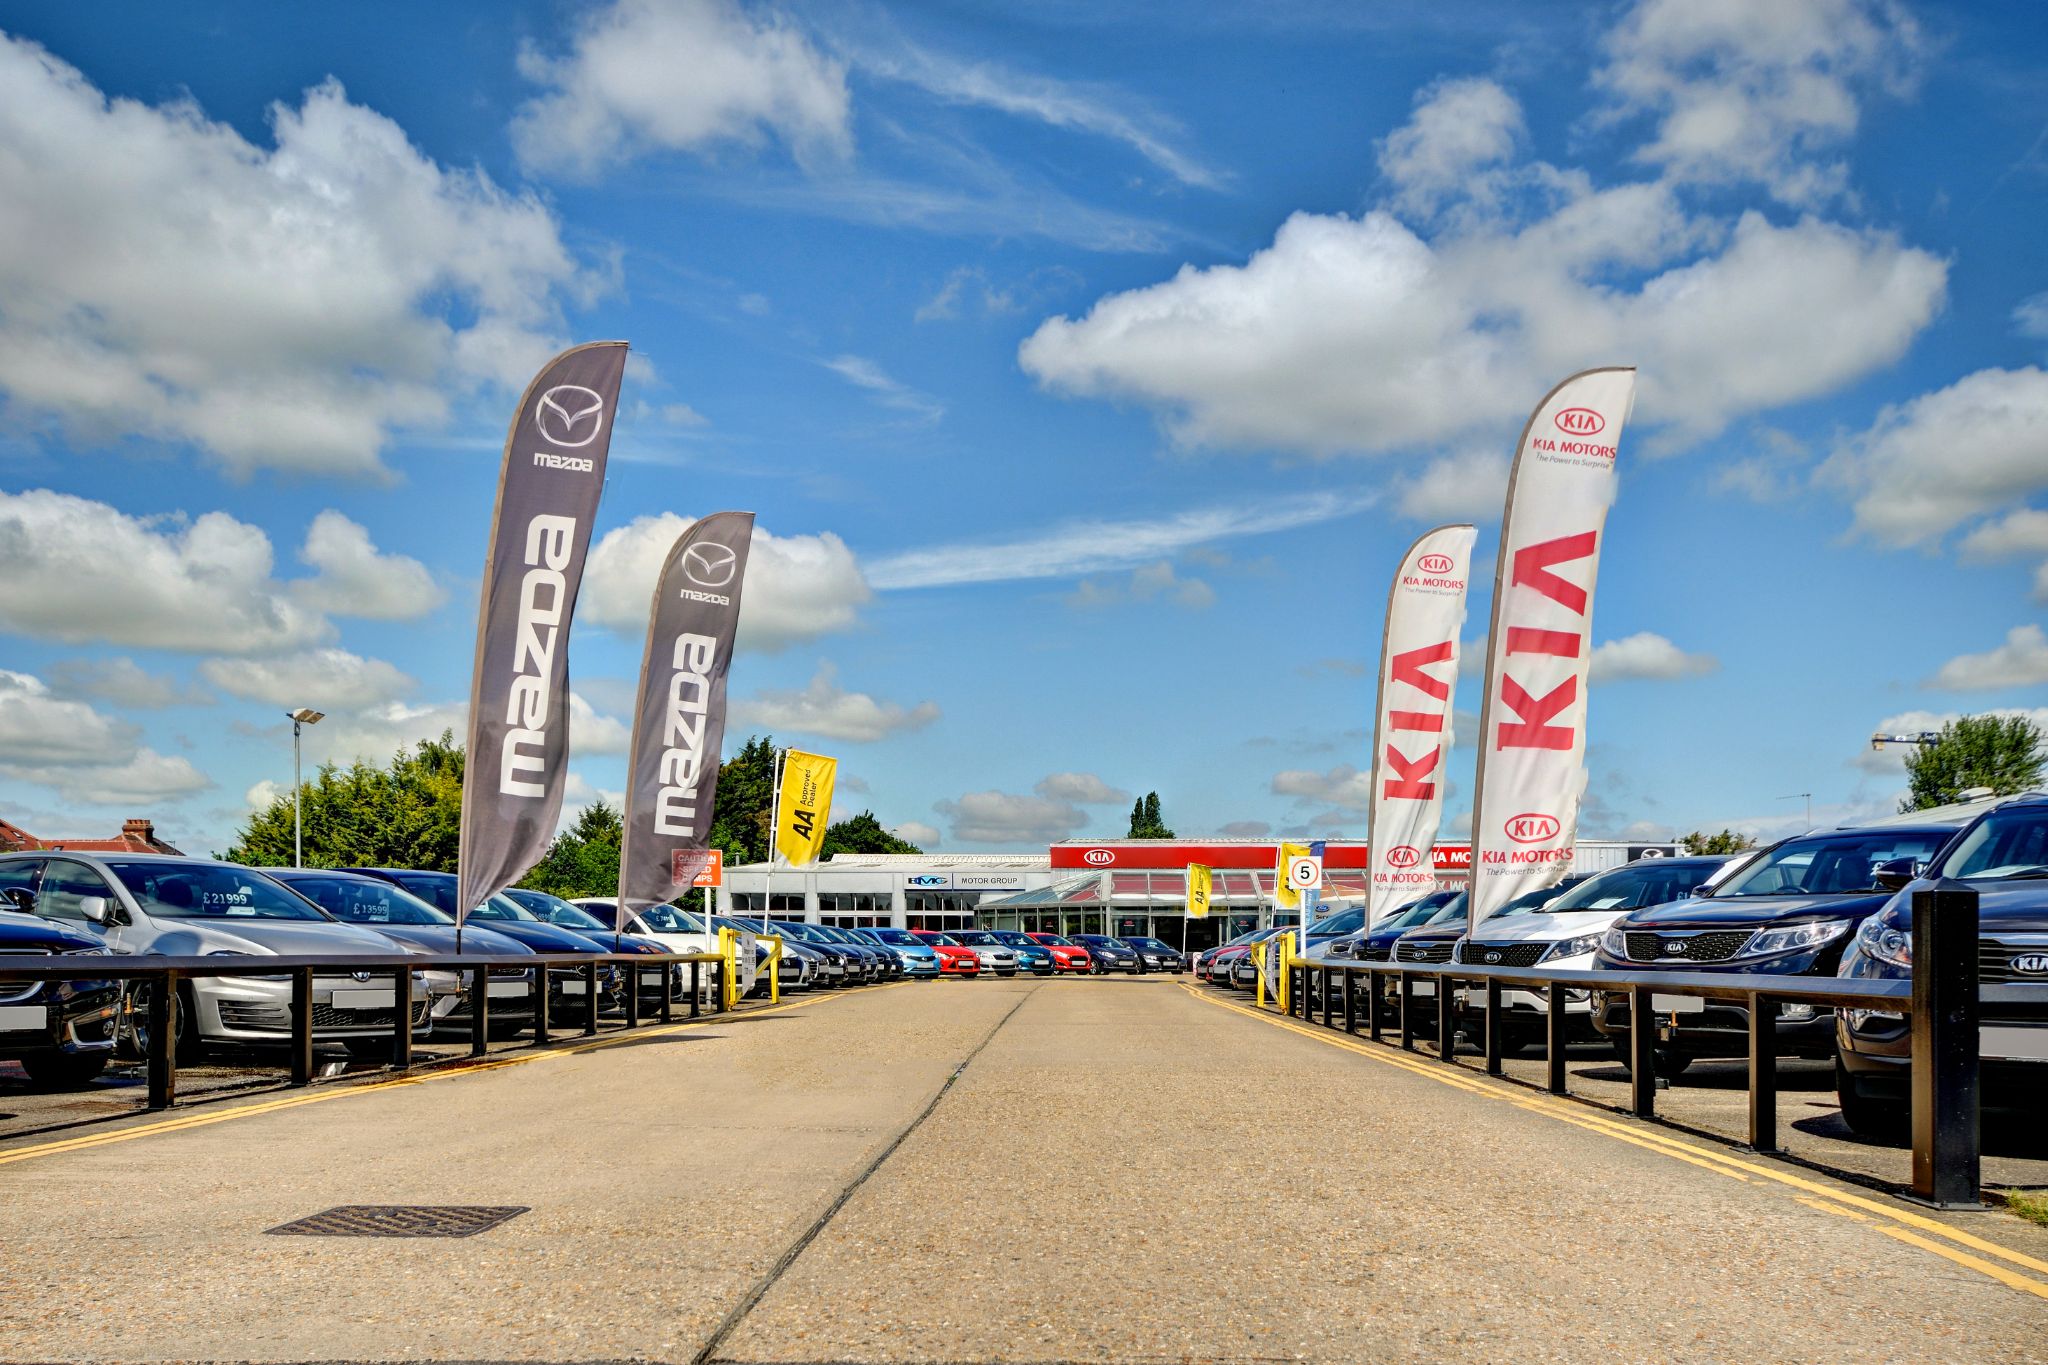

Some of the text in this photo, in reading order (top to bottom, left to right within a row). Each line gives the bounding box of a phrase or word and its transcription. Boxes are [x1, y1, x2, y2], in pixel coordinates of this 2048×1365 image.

[1564, 413, 1596, 430] KIA
[1532, 438, 1616, 459] KIA MOTORS
[1536, 452, 1549, 461] The
[1549, 455, 1571, 464] Power
[1424, 558, 1448, 570] KIA
[1403, 576, 1464, 589] KIA MOTORS
[1497, 530, 1597, 751] KIA
[1384, 640, 1454, 800] KIA
[800, 769, 811, 806] Approved
[807, 782, 818, 807] Dealer
[793, 809, 816, 841] AA
[1514, 820, 1551, 836] KIA
[1090, 853, 1110, 862] KIA
[1392, 850, 1415, 862] KIA
[1433, 852, 1447, 862] IA
[1482, 847, 1574, 863] KIA MOTORS
[1300, 866, 1310, 880] 5
[1373, 873, 1434, 883] KIA MOTORS
[1486, 868, 1499, 876] The
[203, 892, 247, 905] £21999
[1195, 890, 1204, 904] AA
[353, 903, 387, 915] £13599
[2018, 957, 2048, 970] KIA
